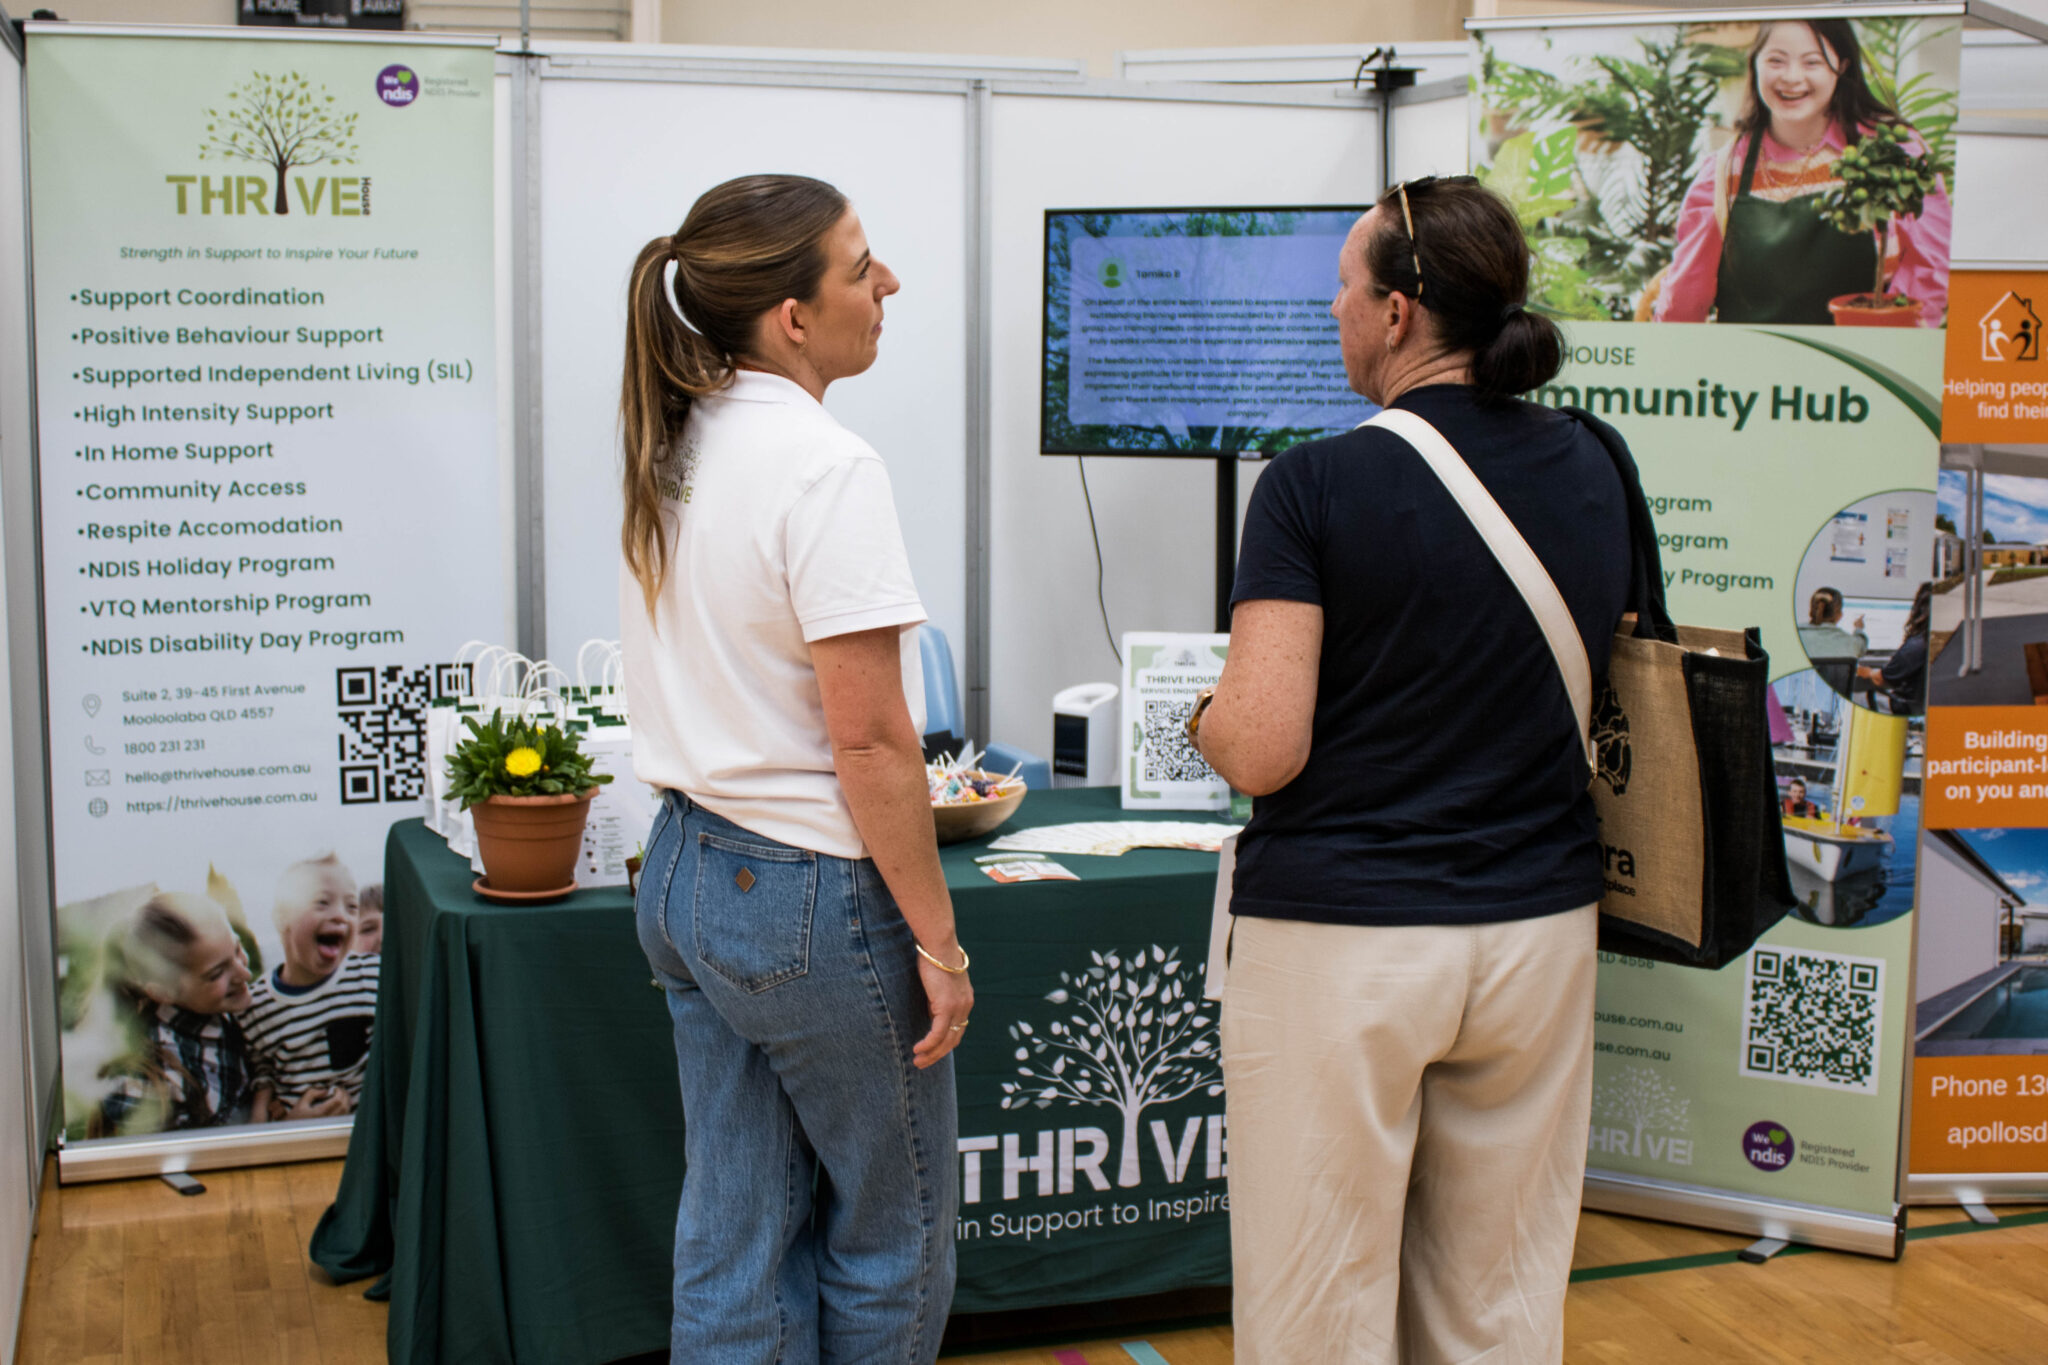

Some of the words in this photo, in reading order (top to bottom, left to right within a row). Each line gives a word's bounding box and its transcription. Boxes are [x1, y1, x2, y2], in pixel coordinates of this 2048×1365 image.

[382, 86, 414, 102] ndis
[166, 175, 361, 216] THRIVE
[361, 176, 371, 216] House
[119, 245, 182, 262] Strength
[187, 246, 200, 260] in
[205, 245, 262, 262] Support
[266, 246, 281, 260] to
[285, 245, 333, 262] Inspire
[338, 246, 369, 260] Your
[373, 246, 418, 260] Future
[79, 288, 171, 310] Support
[177, 288, 325, 307] Coordination
[82, 327, 169, 346] Positive
[177, 325, 290, 344] Behaviour
[296, 325, 383, 348] Support
[1564, 346, 1636, 366] HOUSE
[82, 365, 201, 389] Supported
[208, 364, 350, 388] Independent
[357, 362, 419, 385] Living
[427, 359, 473, 383] (SIL)
[1943, 378, 2005, 399] Helping
[83, 405, 135, 427] High
[142, 402, 239, 425] Intensity
[247, 402, 334, 425] Support
[1525, 378, 1759, 431] mmunity
[1771, 385, 1870, 423] Hub
[1977, 402, 2009, 419] find
[84, 444, 105, 461] In
[111, 444, 178, 460] Home
[185, 442, 274, 464] Support
[85, 480, 221, 502] Community
[228, 479, 306, 498] Access
[1645, 496, 1712, 515] ogram
[87, 521, 171, 543] Respite
[178, 515, 343, 538] Accomodation
[1657, 533, 1728, 553] ogram
[89, 561, 141, 579] NDIS
[147, 558, 232, 579] Holiday
[238, 554, 335, 577] Program
[1681, 568, 1774, 592] Program
[89, 600, 136, 619] VTQ
[142, 594, 269, 616] Mentorship
[276, 592, 371, 614] Program
[92, 638, 143, 657] NDIS
[150, 632, 253, 655] Disability
[260, 631, 303, 653] Day
[309, 628, 404, 649] Program
[1146, 674, 1184, 684] THRIVE
[123, 689, 158, 703] Suite
[161, 688, 172, 701] 2,
[176, 685, 218, 699] 39-45
[222, 685, 250, 698] First
[255, 683, 305, 696] Avenue
[1140, 687, 1171, 695] SERVICE
[123, 710, 207, 726] Mooloolaba
[211, 708, 237, 723] QLD
[241, 707, 274, 720] 4557
[125, 741, 156, 755] 1800
[160, 740, 181, 753] 231
[185, 739, 205, 753] 231
[1965, 730, 2048, 753] Building
[125, 762, 311, 785] hello@thrivehouse.com.au
[1927, 755, 2048, 779] participant-l
[127, 791, 318, 815] https://thrivehouse.com.au
[1945, 785, 1971, 799] on
[1976, 784, 2013, 804] you
[1597, 951, 1616, 964] LD
[1594, 1010, 1684, 1034] ouse.com.au
[1594, 1041, 1671, 1062] se.com.au
[1931, 1074, 2008, 1097] Phone
[2016, 1074, 2048, 1096] 13
[1588, 1124, 1688, 1166] HRIVE
[1752, 1132, 1771, 1145] We
[1947, 1120, 2048, 1150] apollosd
[957, 1114, 1228, 1204] THRIVE
[1750, 1146, 1786, 1166] ndis
[1800, 1140, 1856, 1158] Registered
[1800, 1153, 1826, 1166] NDIS
[1828, 1157, 1870, 1173] Provider
[956, 1216, 981, 1240] in
[990, 1206, 1104, 1241] Support
[1111, 1203, 1140, 1225] to
[1148, 1190, 1231, 1223] Inspire
